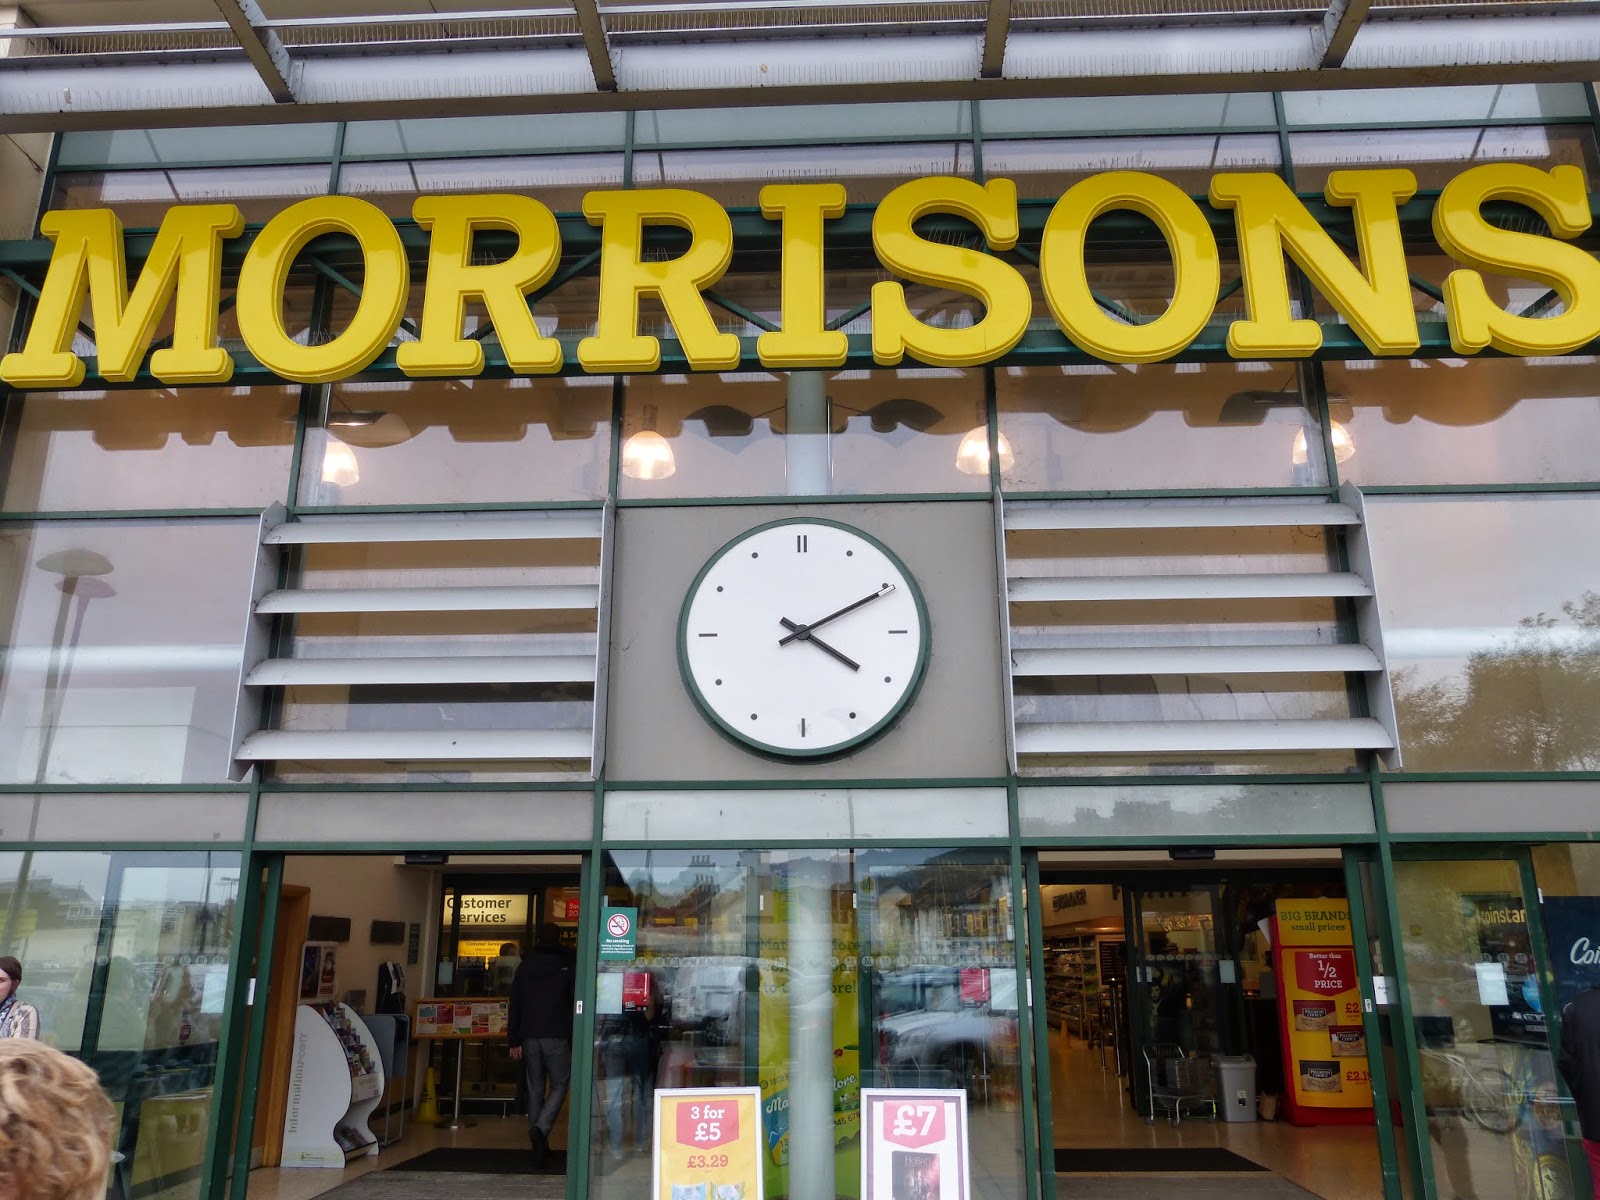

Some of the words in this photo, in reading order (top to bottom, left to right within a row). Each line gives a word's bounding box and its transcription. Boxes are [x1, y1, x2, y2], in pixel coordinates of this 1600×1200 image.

[0, 162, 1600, 389] MORRISONS
[452, 911, 507, 923] ervices
[1280, 911, 1301, 921] BIG
[1291, 922, 1315, 931] small
[1318, 923, 1346, 932] prices
[1314, 980, 1343, 988] PRICE
[690, 1105, 700, 1120] 3
[703, 1104, 725, 1120] for
[892, 1104, 937, 1137] £7
[694, 1122, 721, 1141] £5
[687, 1154, 729, 1169] £3.29
